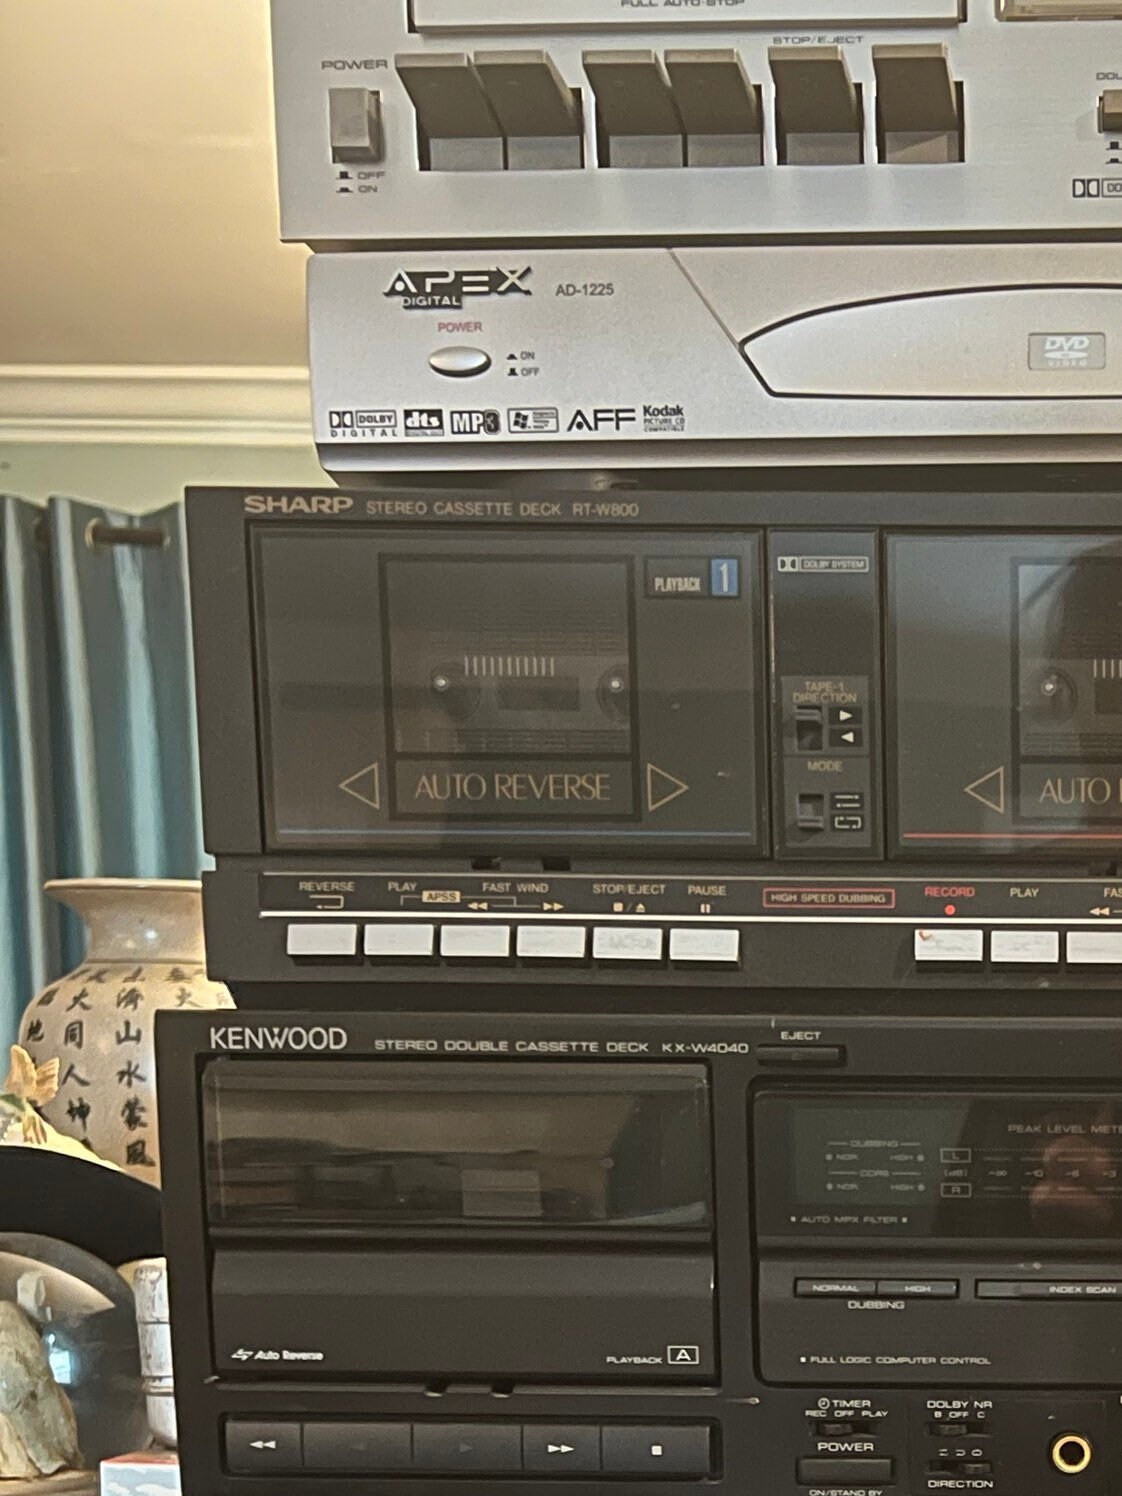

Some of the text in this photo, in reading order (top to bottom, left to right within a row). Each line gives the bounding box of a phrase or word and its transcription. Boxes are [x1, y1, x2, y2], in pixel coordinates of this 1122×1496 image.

[321, 59, 388, 71] POWER
[357, 170, 386, 182] OFF
[357, 184, 378, 195] ON
[383, 267, 532, 296] APEX
[554, 283, 616, 297] AD-1225
[400, 295, 462, 308] DIGITAL
[437, 321, 484, 334] POWER
[1045, 336, 1089, 350] DVD
[519, 350, 536, 362] ON
[519, 367, 541, 377] OFF
[642, 404, 685, 417] Kodak
[357, 414, 394, 424] DOLBY
[451, 411, 500, 434] MP3
[330, 428, 398, 438] DIGITAL
[245, 496, 639, 518] SHARP STEREO CASSETTE DECK RT-W800
[718, 561, 730, 592] 1
[654, 577, 701, 592] PLAYBACK
[807, 759, 844, 772] MODE
[415, 774, 611, 800] AUTO REVERSE
[1040, 778, 1110, 804] AUTO
[298, 880, 356, 893] REVERSE
[387, 880, 418, 893] PLAY
[482, 881, 549, 893] FAST WIND
[687, 884, 727, 897] PAUSE
[924, 886, 976, 899] RECORD
[1009, 887, 1040, 899] PLAY
[210, 1028, 749, 1055] KENWOOD STEREO DOUBLE CASSETTE DECK KX-W4040
[780, 1030, 821, 1042] EJECT
[809, 1355, 992, 1366] FULL LOGIC COMPUTER CONTROL
[926, 1400, 993, 1410] DOLBY NR
[817, 1441, 875, 1453] POWER
